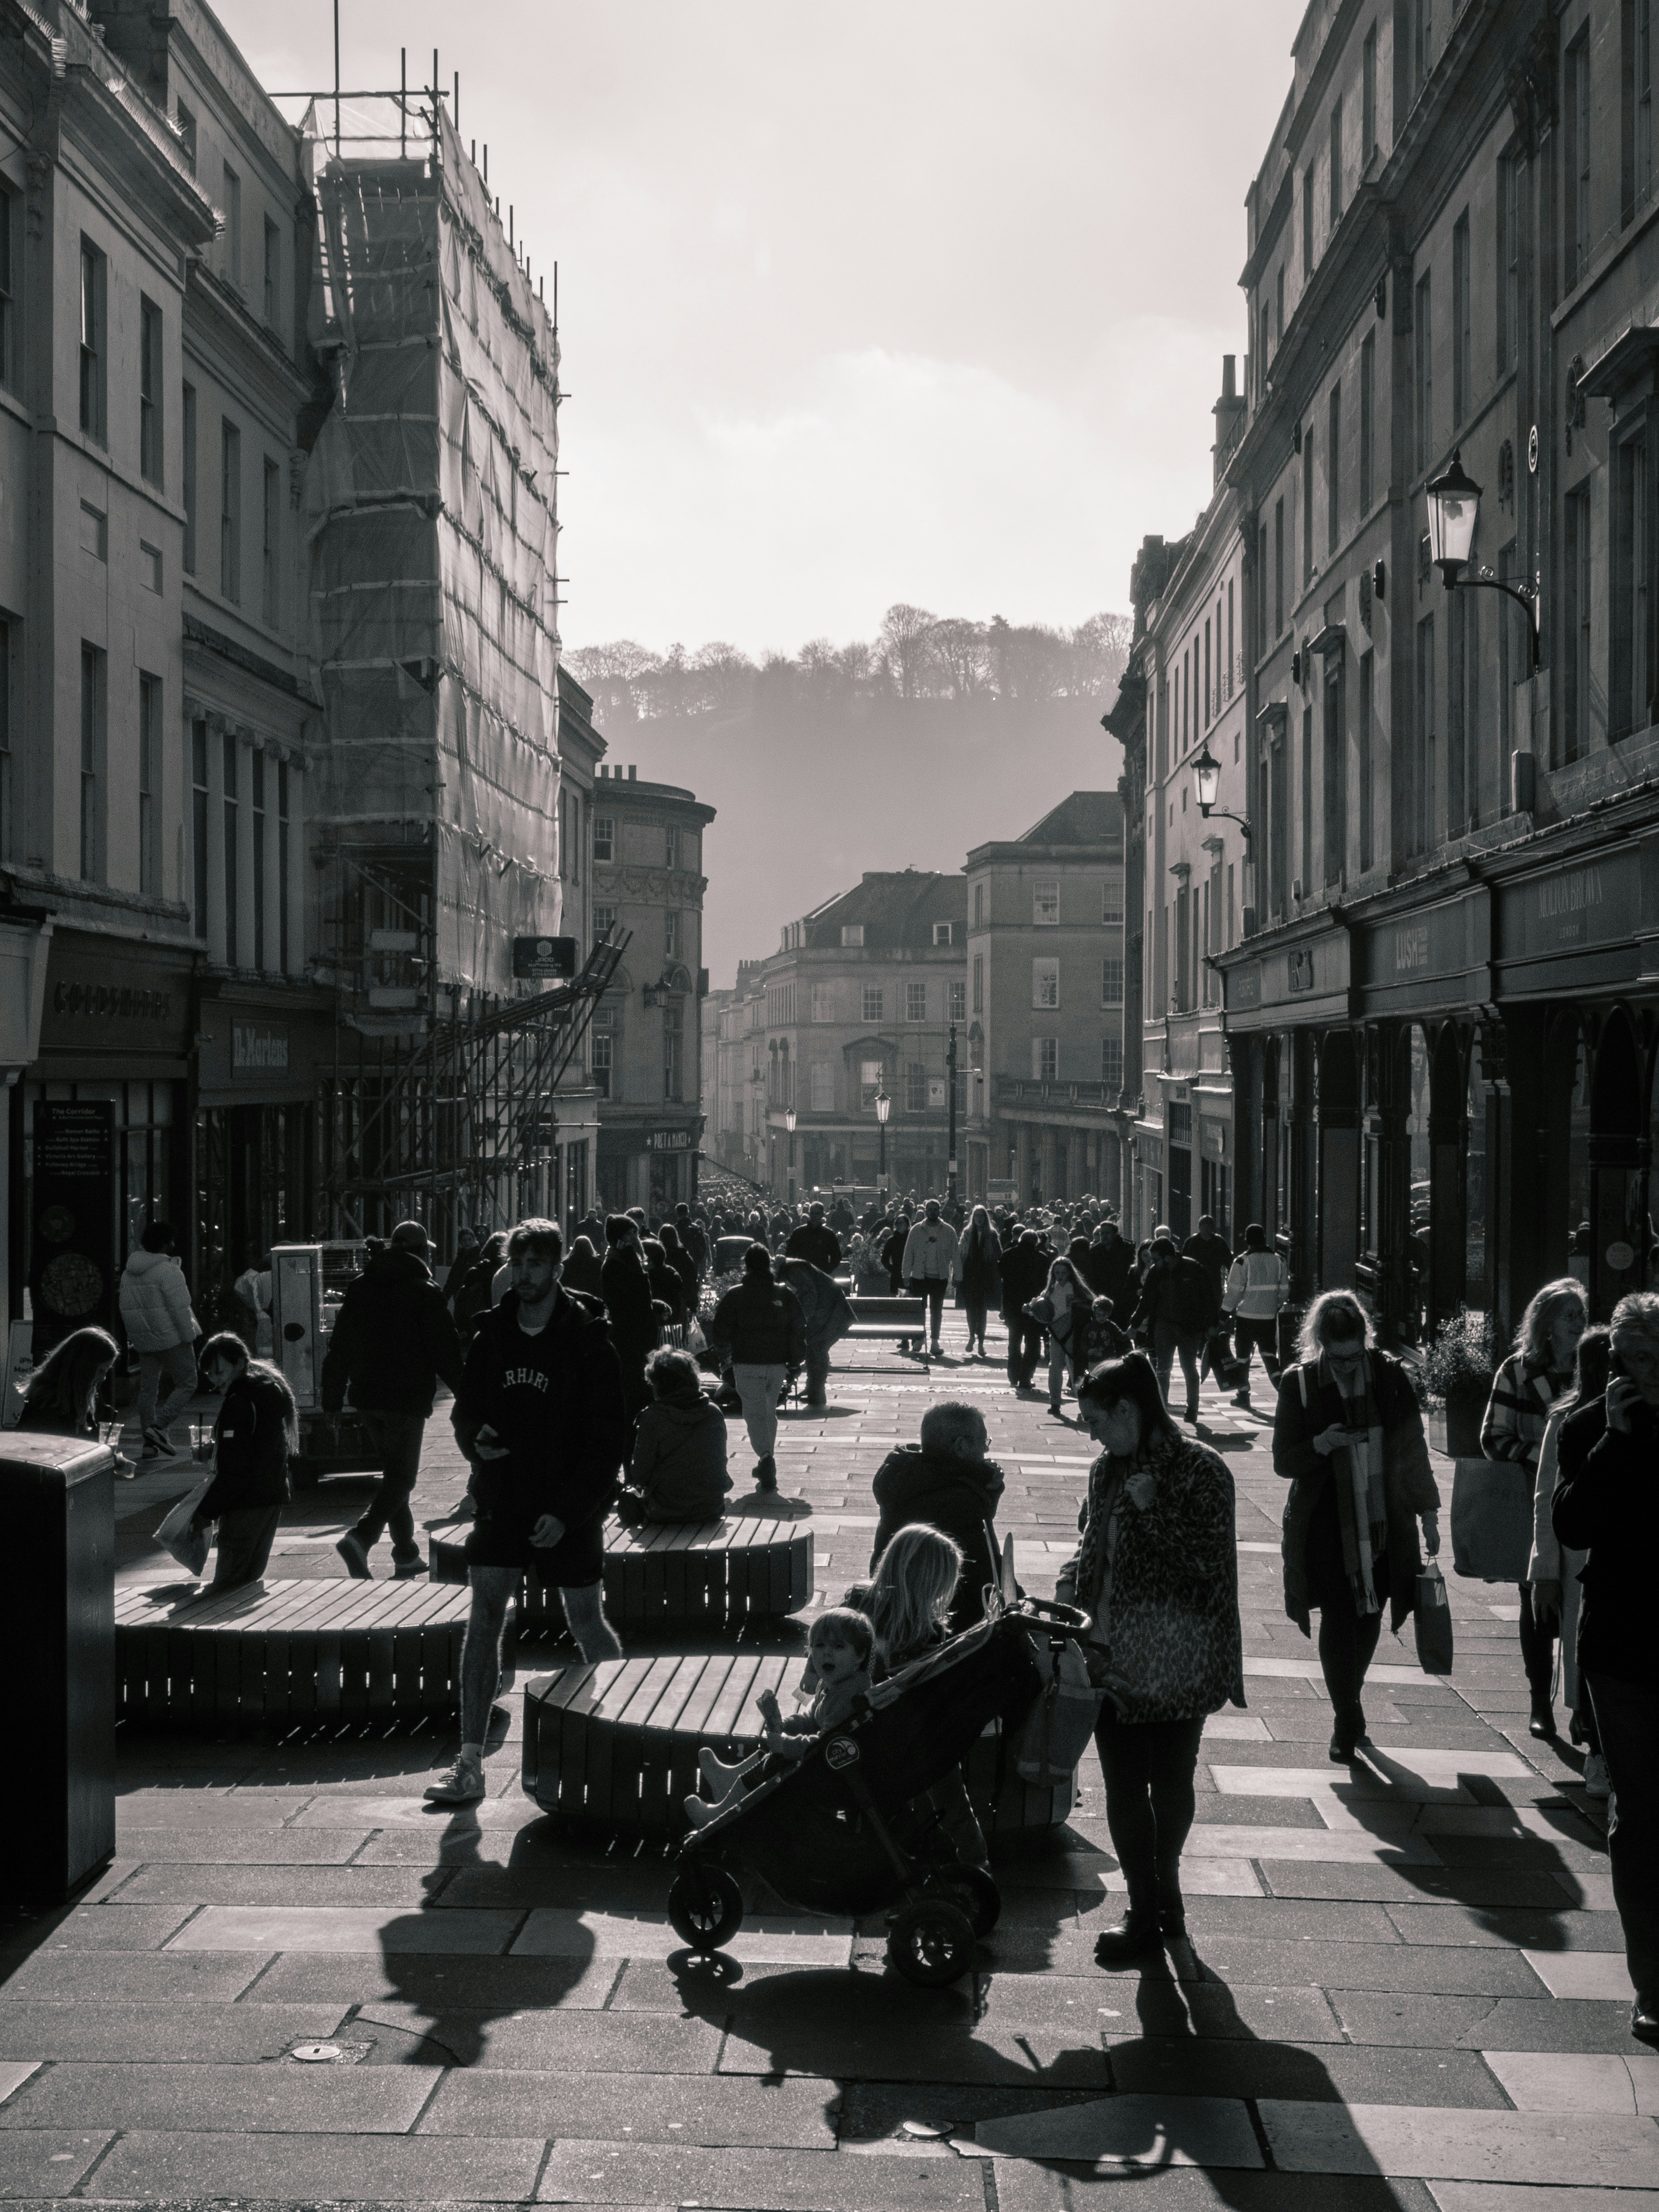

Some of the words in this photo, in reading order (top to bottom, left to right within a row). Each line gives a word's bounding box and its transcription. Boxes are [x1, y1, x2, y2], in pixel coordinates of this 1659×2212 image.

[1570, 866, 1602, 911] BROWN
[1396, 928, 1418, 970] LUSH
[54, 980, 171, 1019] GOLDSMITHS
[246, 1028, 289, 1067] Martens
